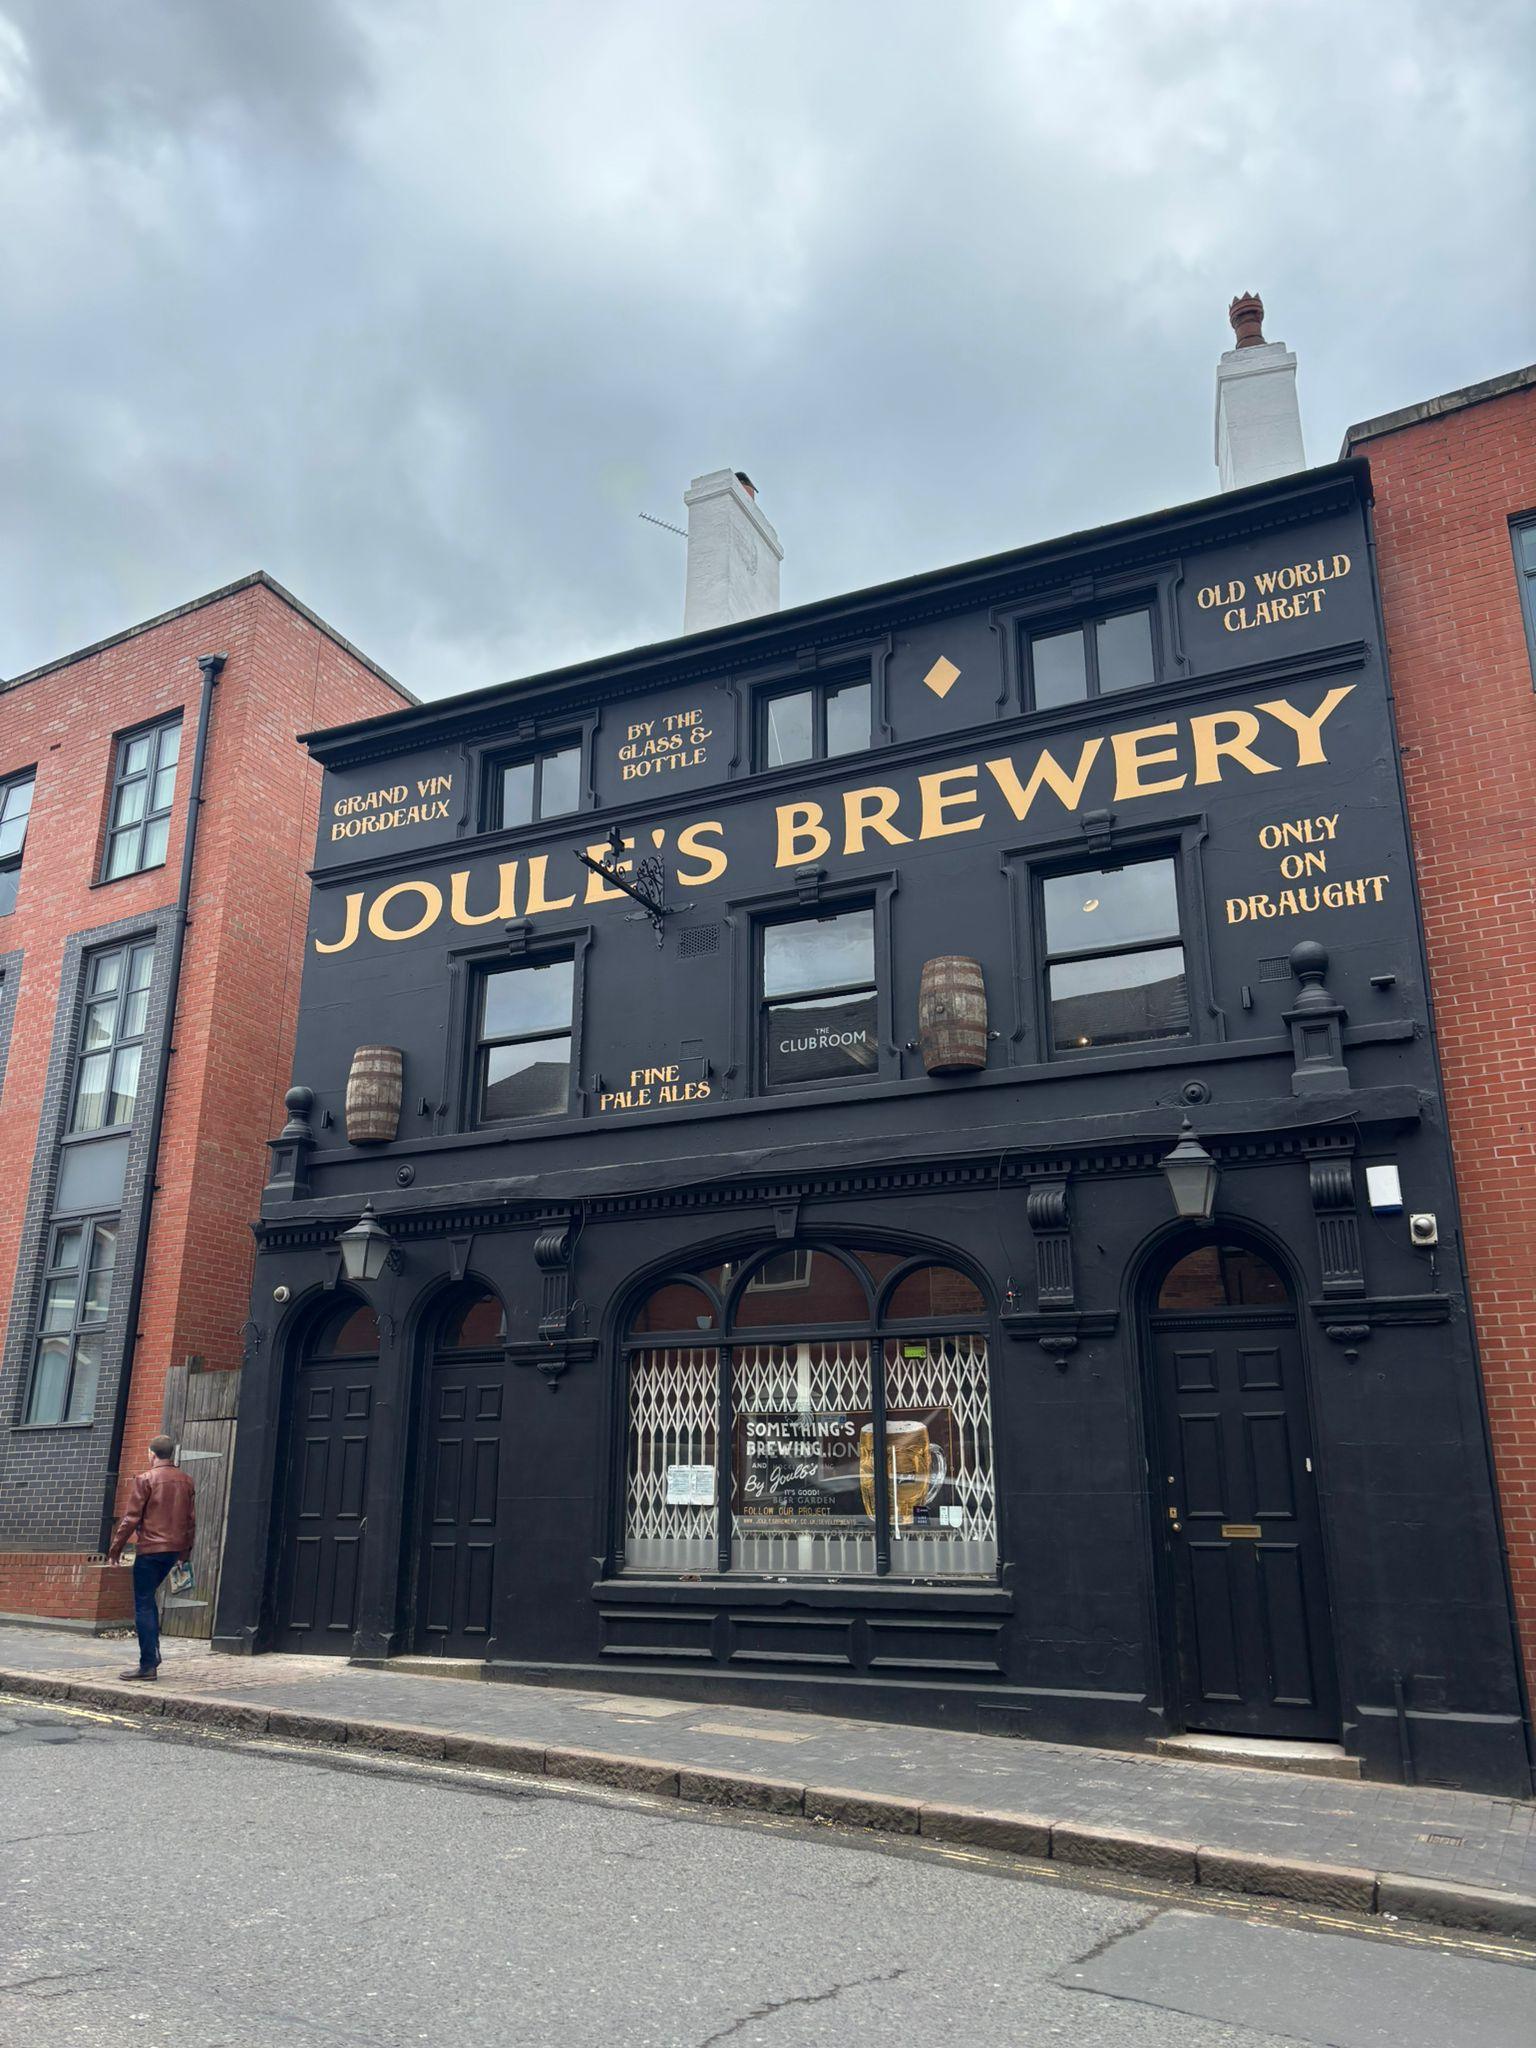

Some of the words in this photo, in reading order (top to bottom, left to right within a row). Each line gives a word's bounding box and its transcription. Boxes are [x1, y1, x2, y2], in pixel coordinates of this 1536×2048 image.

[1197, 580, 1246, 610] OLD
[1253, 553, 1352, 595] WORLD
[1223, 589, 1328, 633] CLARET
[627, 717, 655, 742] BY
[664, 708, 704, 731] THE
[617, 734, 684, 762] GLASS
[689, 726, 713, 747] &
[621, 747, 708, 781] BOTTLE
[333, 785, 409, 818] GRAND
[416, 774, 454, 797] VIN
[314, 820, 728, 954] JOULE'S
[774, 684, 1358, 869] BREWERY
[330, 799, 452, 842] BORDEAUX
[1258, 813, 1341, 850] ONLY
[1279, 850, 1327, 881] ON
[1226, 874, 1390, 925] DRAUGHT
[815, 1026, 830, 1035] THE
[629, 1065, 681, 1089] FINE
[599, 1089, 653, 1111] PALE
[658, 1081, 711, 1107] ALES
[746, 1420, 856, 1438] SOMETHING'S
[744, 1474, 765, 1498] By
[797, 1488, 820, 1496] GOOD!
[797, 1496, 836, 1504] GARDEN
[743, 1506, 774, 1516] FOLLOW
[778, 1506, 794, 1516] OUR
